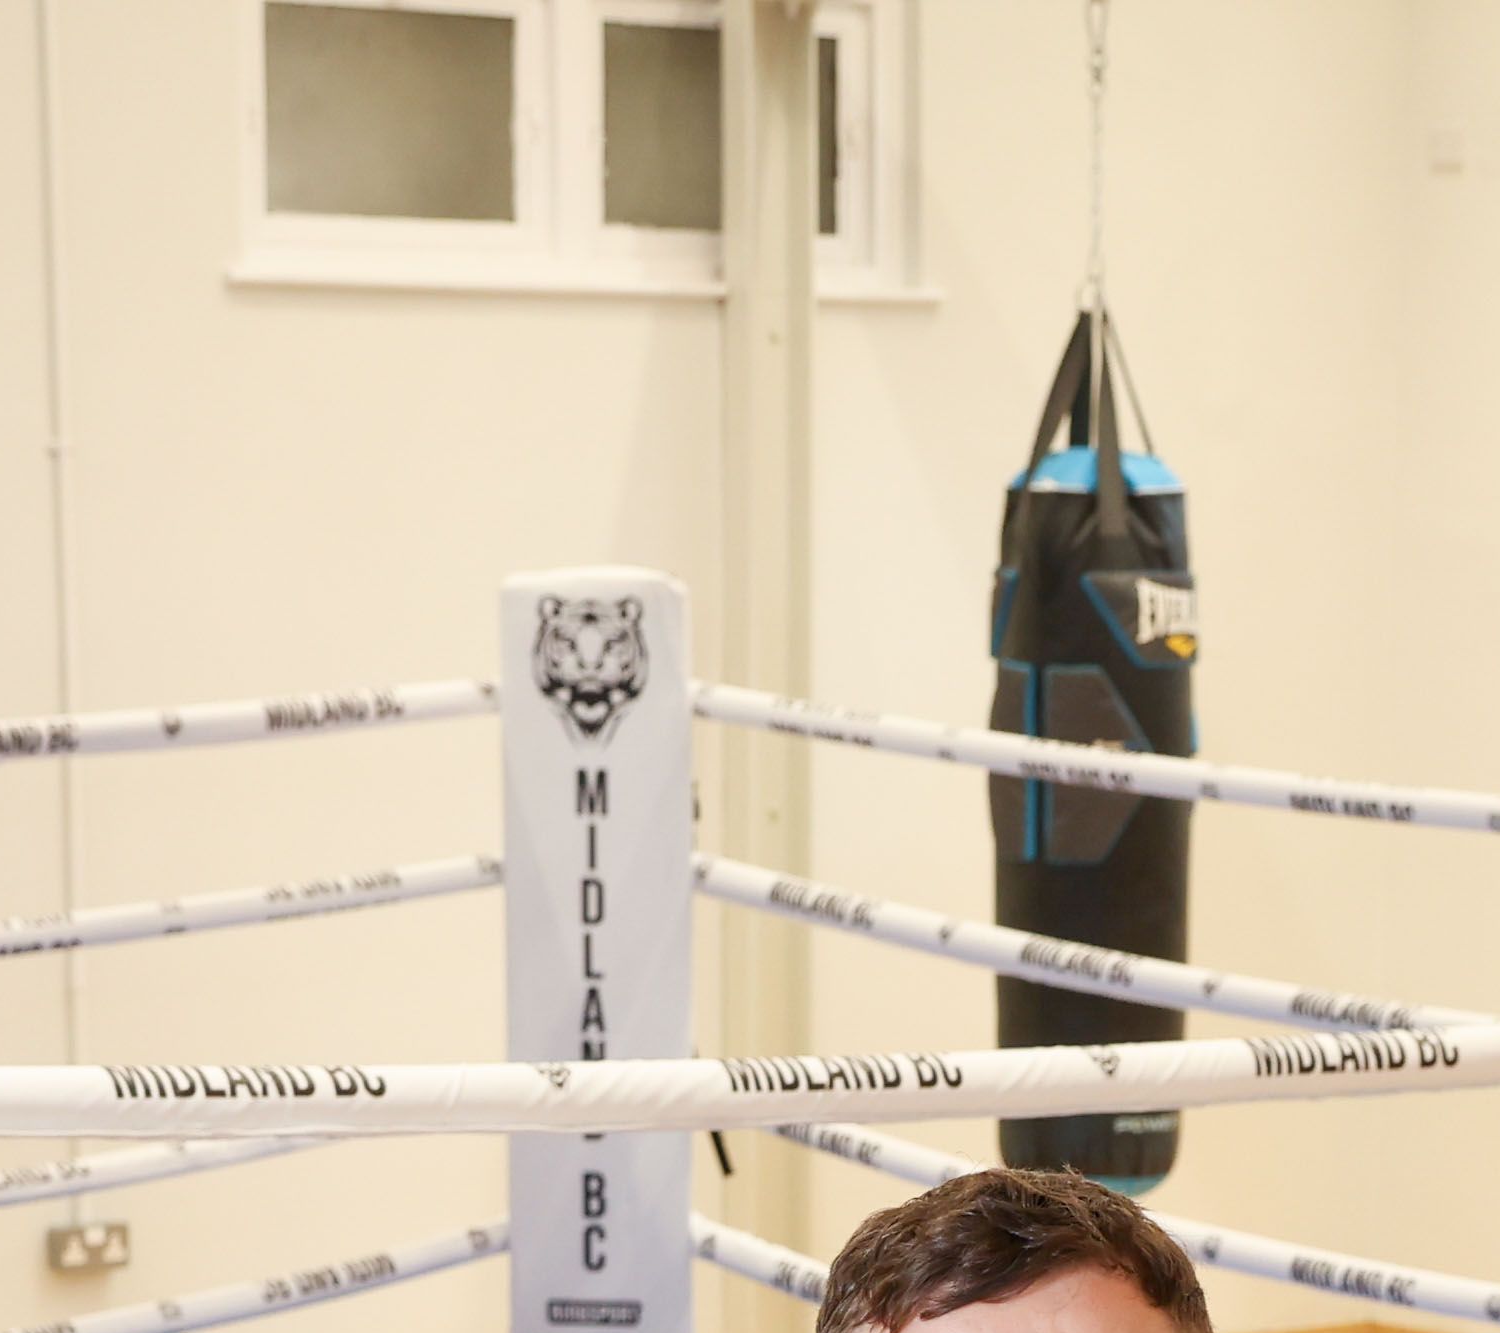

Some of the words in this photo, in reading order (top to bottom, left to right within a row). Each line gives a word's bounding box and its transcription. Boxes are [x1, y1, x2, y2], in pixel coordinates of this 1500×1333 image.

[264, 692, 370, 731] MIDLAND
[372, 690, 405, 718] BC
[48, 722, 79, 755] BC
[722, 1054, 902, 1093] MIDLAND
[909, 1051, 965, 1090] BC
[1245, 1030, 1406, 1078] MIDLAND
[1412, 1026, 1461, 1070] BC
[103, 1066, 316, 1099] MIDLAND
[324, 1065, 387, 1099] BC
